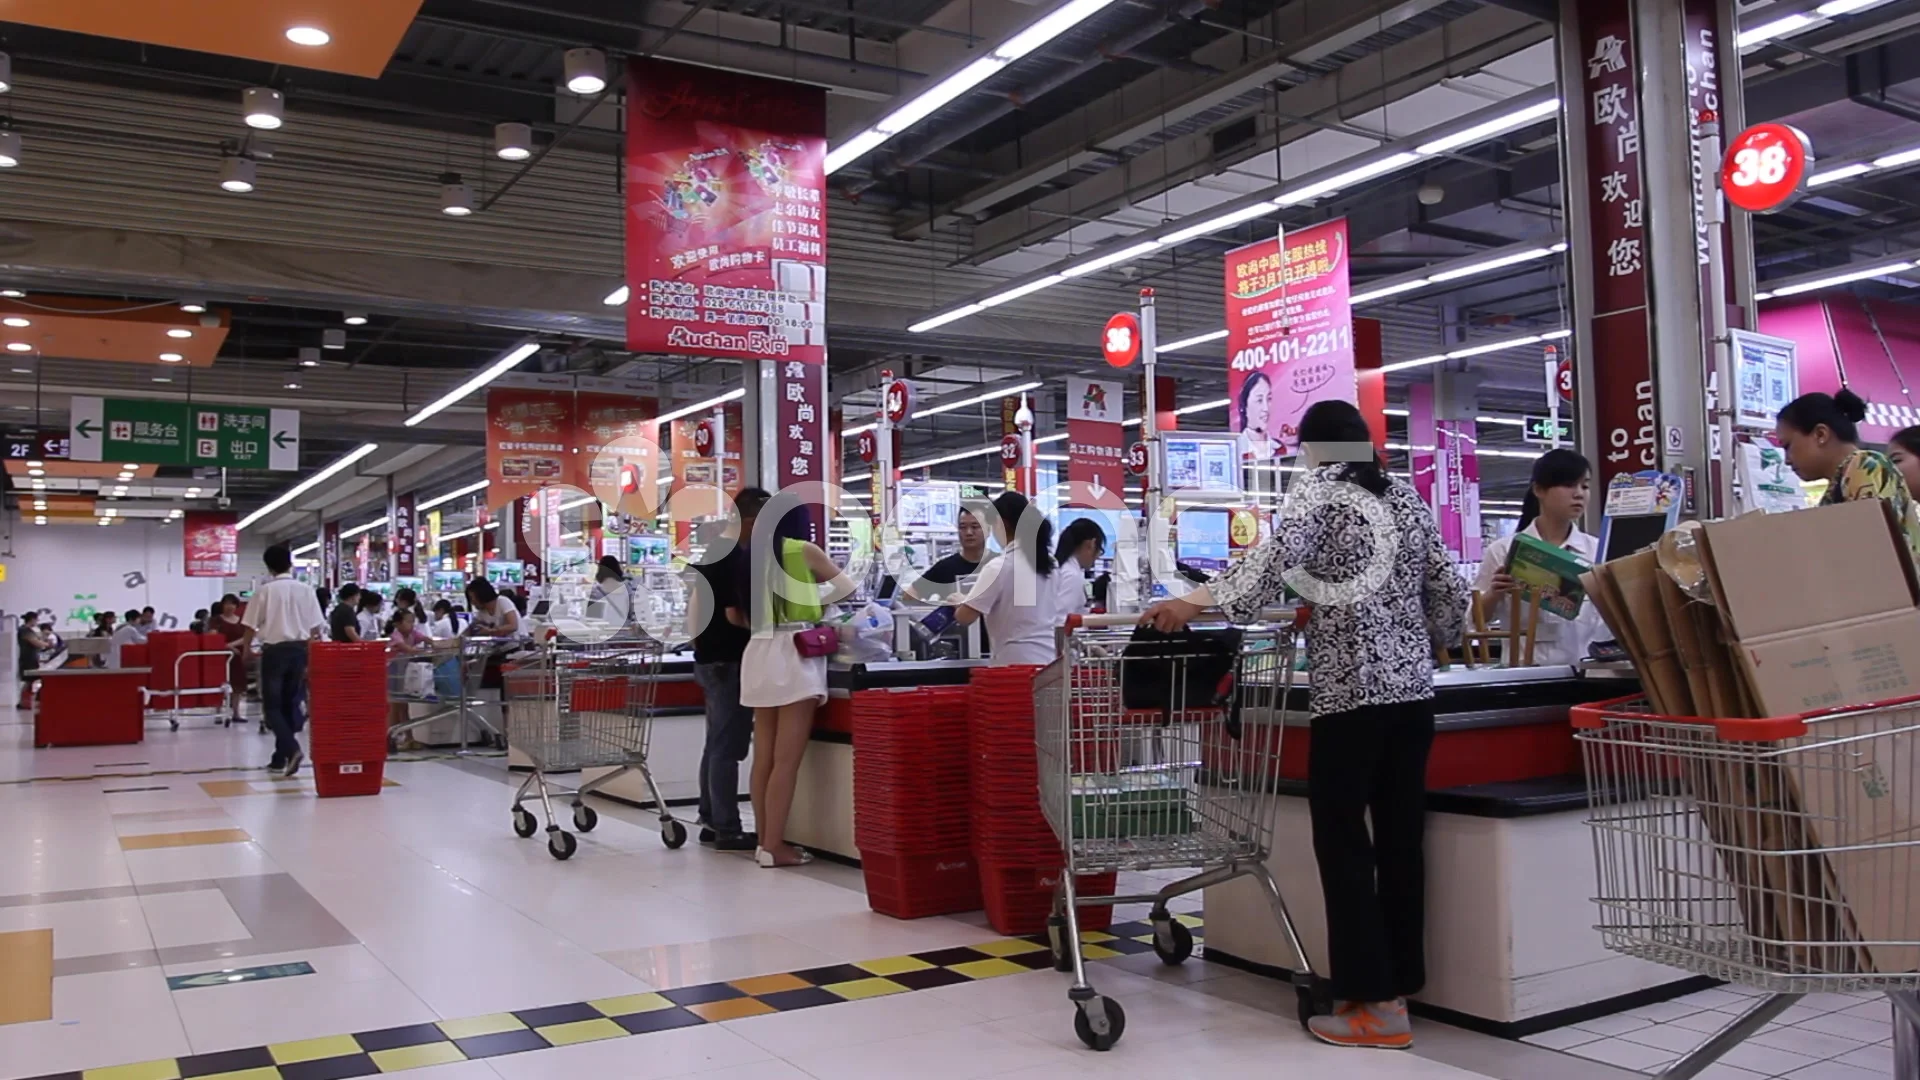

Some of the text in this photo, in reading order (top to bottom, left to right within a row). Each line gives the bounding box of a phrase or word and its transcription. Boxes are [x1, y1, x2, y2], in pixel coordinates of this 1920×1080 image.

[1731, 147, 1786, 187] 38
[1593, 83, 1642, 277] 欧尚欢迎您
[670, 245, 719, 269] 欢迎使用
[708, 251, 765, 271] 欧尚购物卡
[668, 326, 788, 355] Auchan 欧尚
[1106, 327, 1131, 352] 36
[1231, 325, 1349, 372] 400-101-2211
[134, 421, 179, 438] 服务台
[223, 413, 265, 429] 洗手间
[786, 383, 815, 475] 欧尚欢迎您
[11, 444, 30, 457] 2F
[230, 440, 258, 454] 出口
[859, 438, 871, 454] 31
[1001, 444, 1016, 459] 32
[1607, 428, 1629, 463] to
[1129, 450, 1145, 467] 33
[1233, 526, 1249, 538] 22
